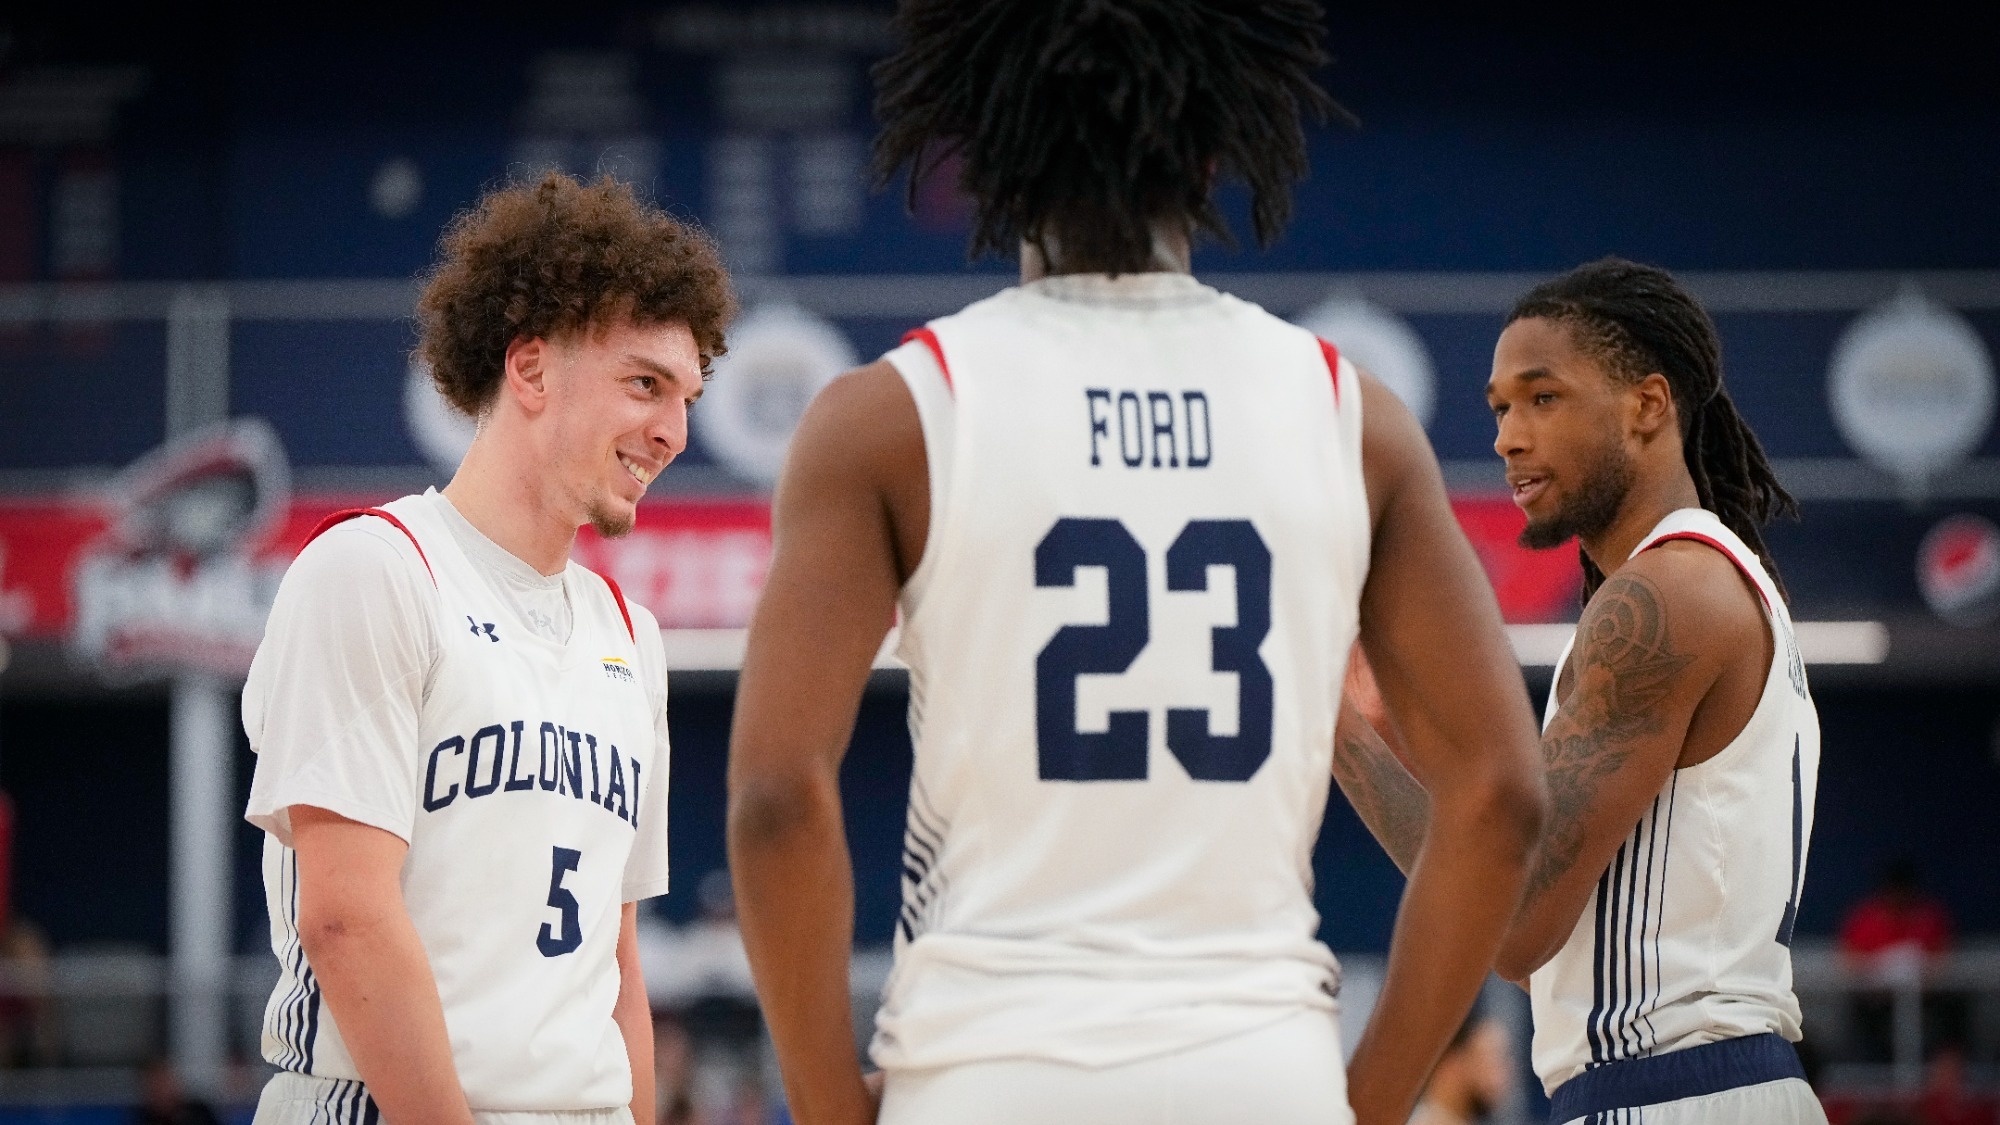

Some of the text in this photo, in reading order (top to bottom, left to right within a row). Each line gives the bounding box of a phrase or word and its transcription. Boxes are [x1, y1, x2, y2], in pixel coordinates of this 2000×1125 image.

[1086, 387, 1212, 468] FORD
[1035, 517, 1275, 782] 23
[536, 845, 583, 958] 5
